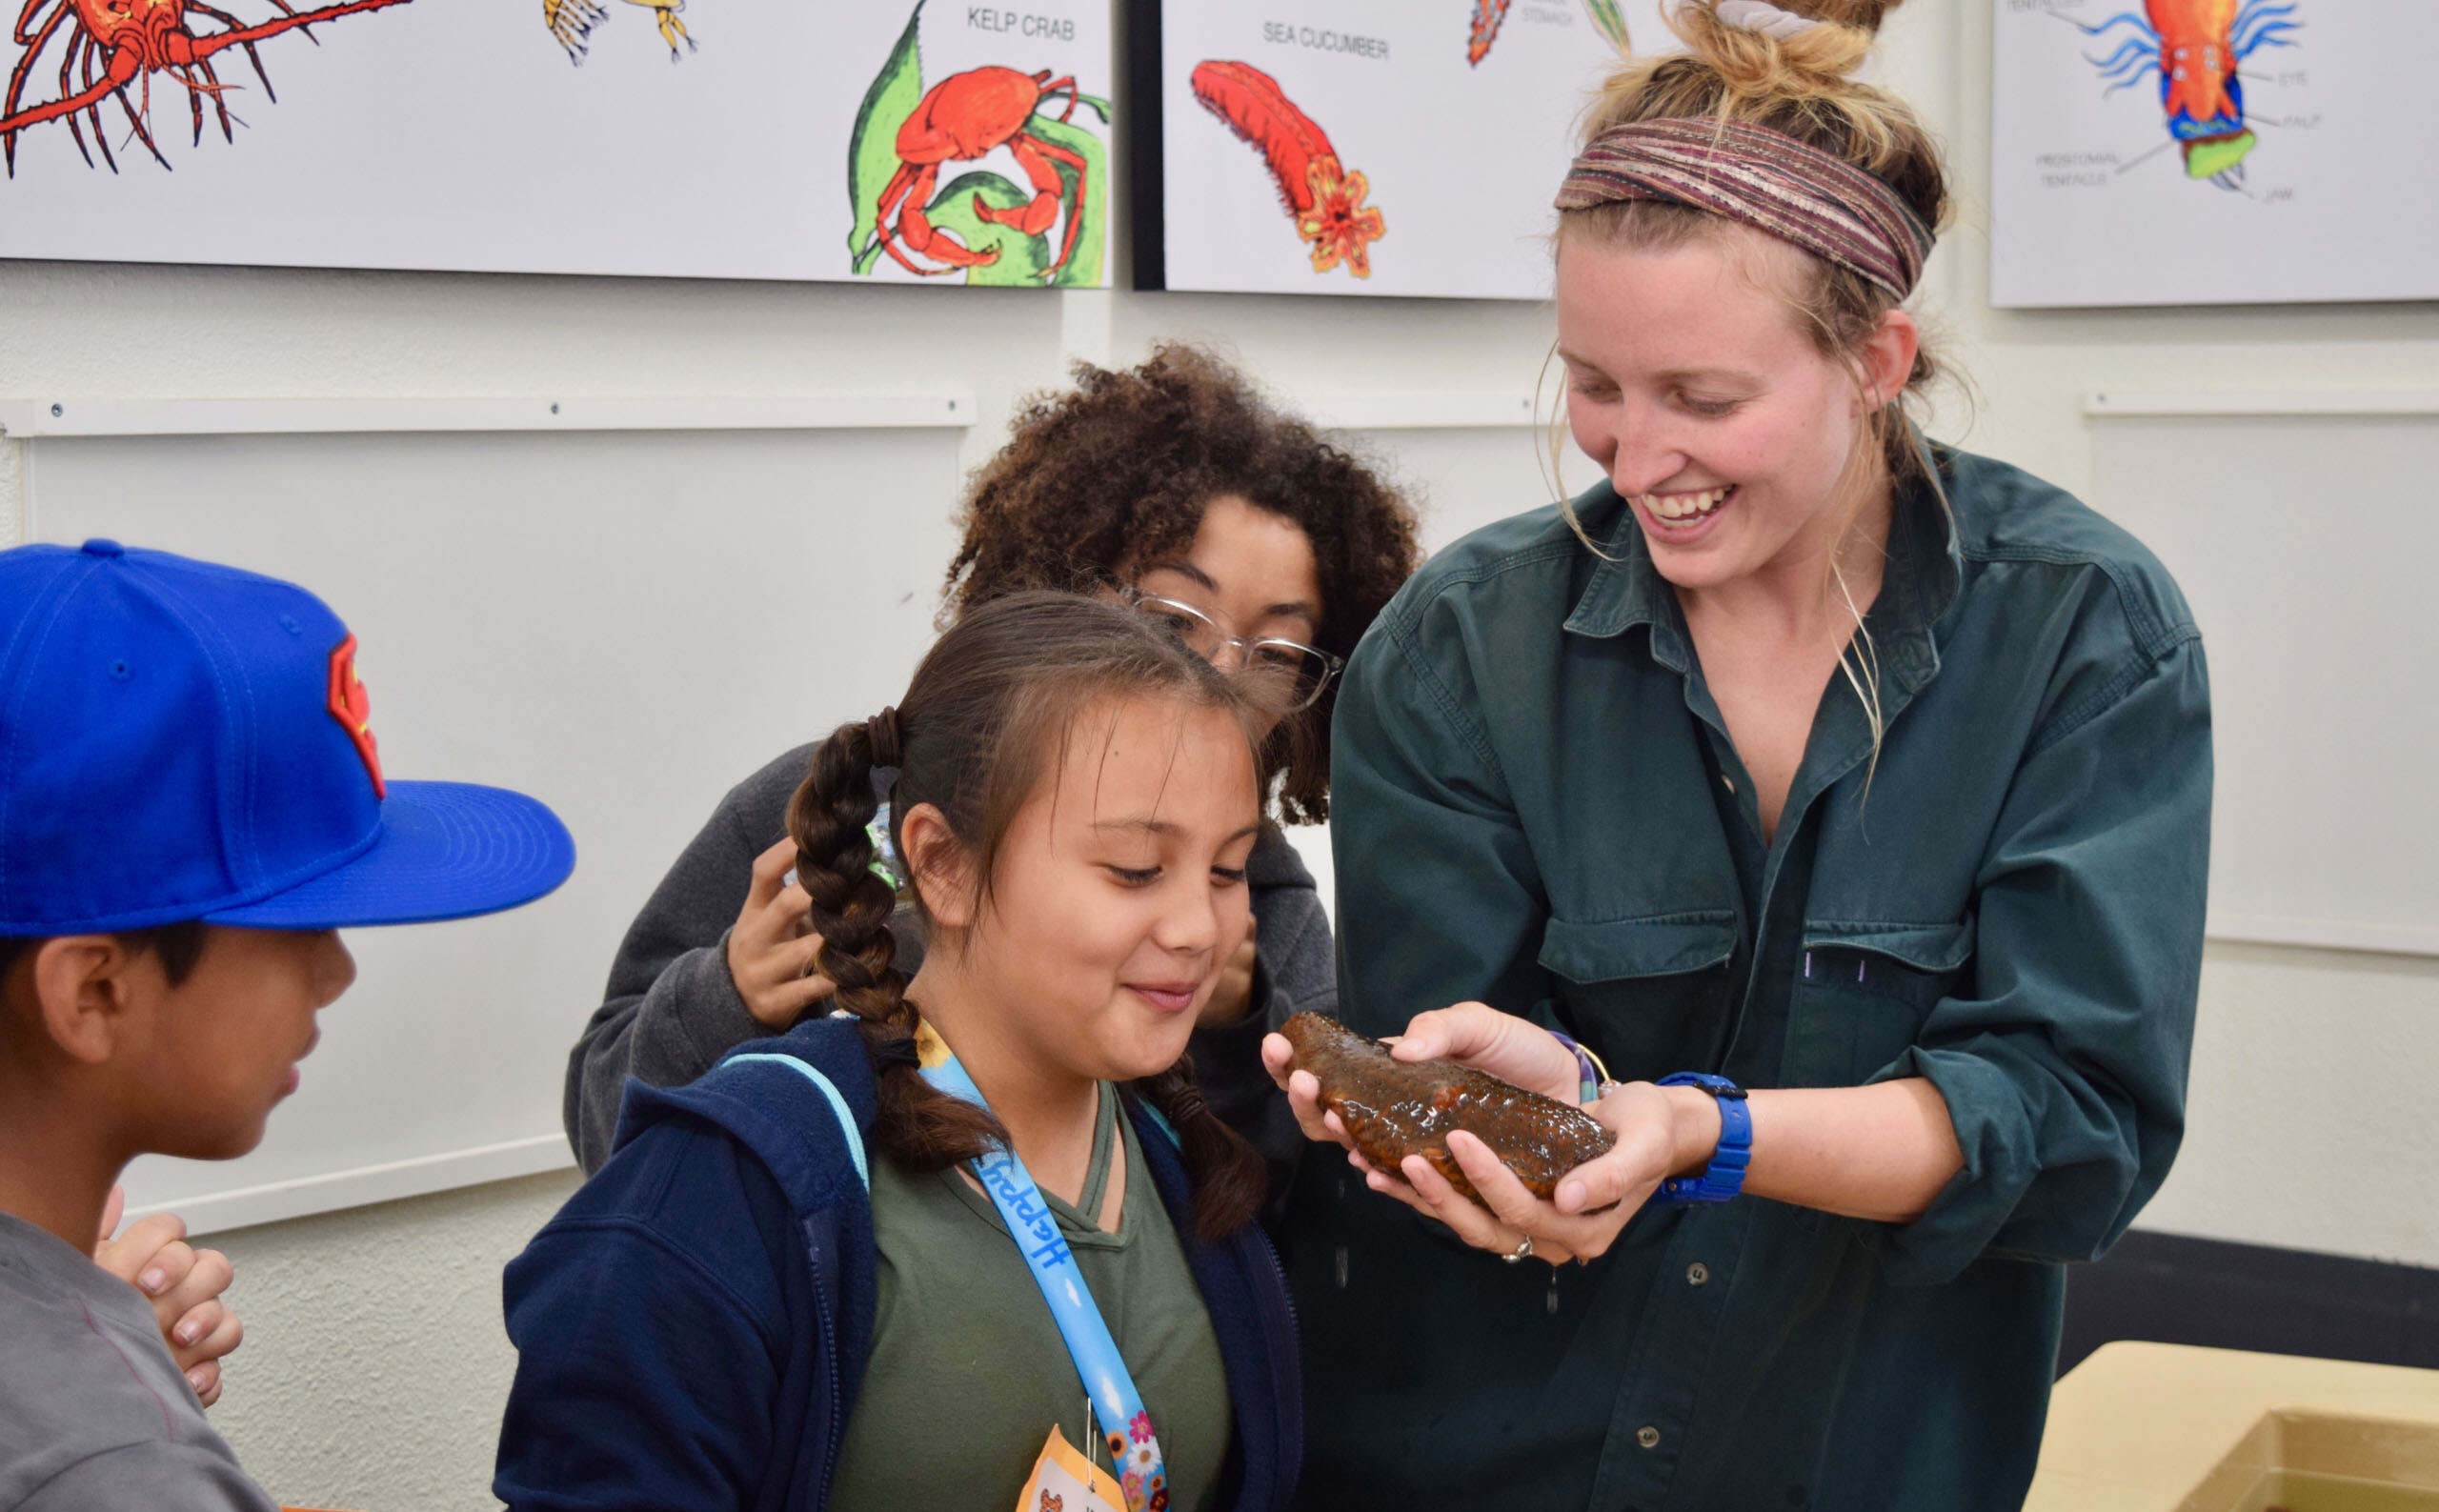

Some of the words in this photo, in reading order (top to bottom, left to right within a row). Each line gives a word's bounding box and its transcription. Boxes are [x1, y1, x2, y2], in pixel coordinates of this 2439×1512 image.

[967, 7, 1017, 32] KELP
[1021, 15, 1075, 41] CRAB
[1263, 21, 1296, 44] SEA
[1300, 27, 1389, 60] CUCUMBER
[980, 1159, 1070, 1269] Happy
